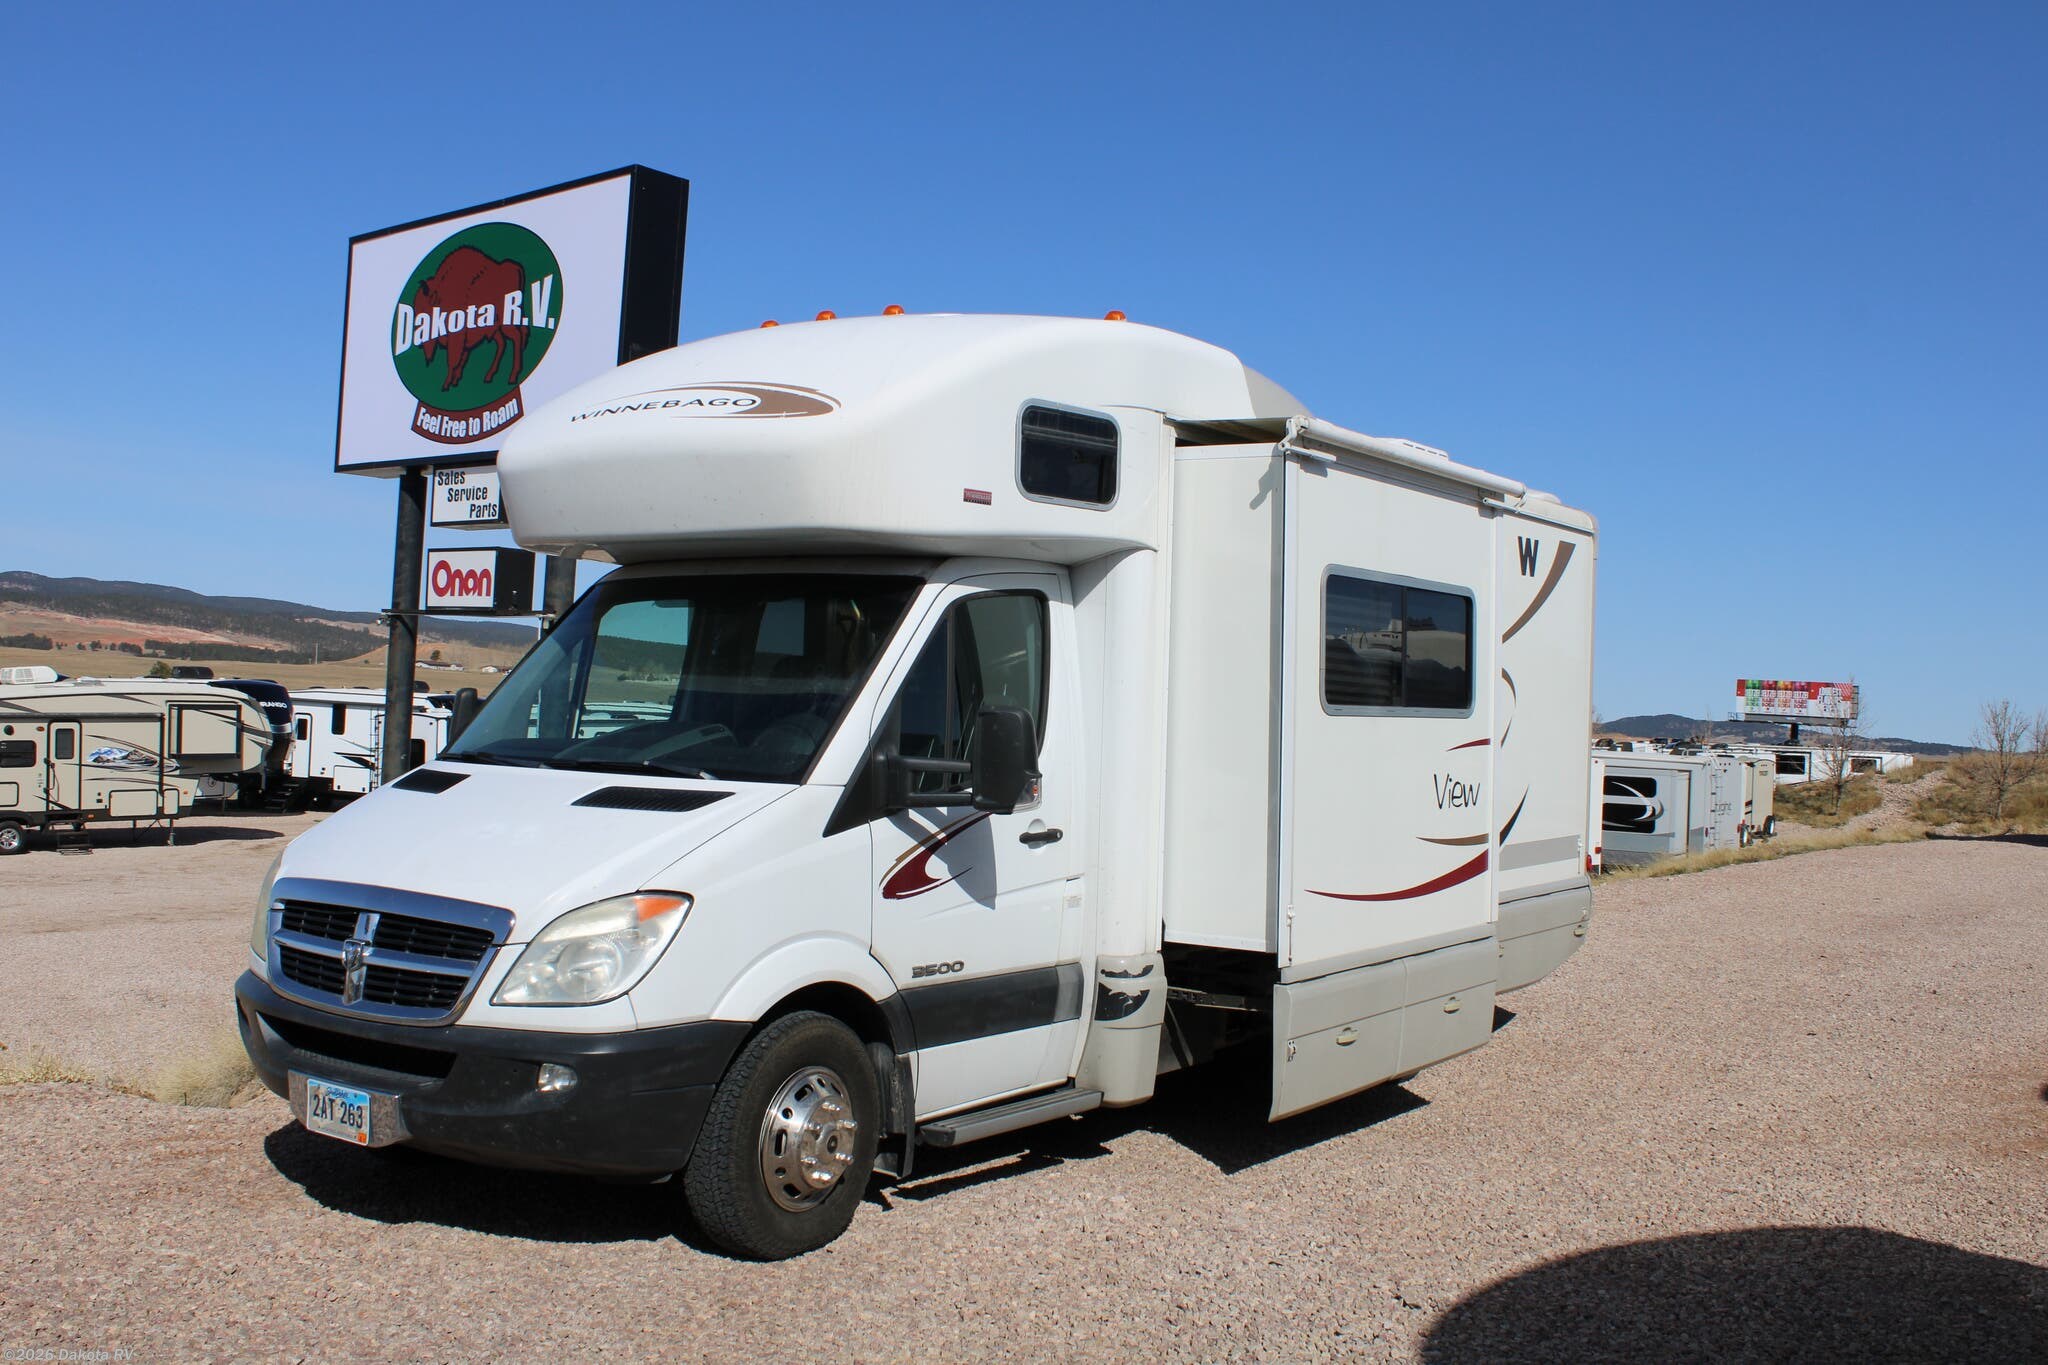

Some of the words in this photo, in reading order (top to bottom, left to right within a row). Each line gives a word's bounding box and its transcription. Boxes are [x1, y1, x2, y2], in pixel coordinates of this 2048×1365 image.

[395, 302, 496, 357] Dakota
[503, 273, 555, 330] R.V.
[416, 406, 442, 435] Feel
[440, 415, 467, 438] Free
[468, 417, 481, 436] to
[482, 398, 519, 433] Roam
[571, 398, 757, 423] WINNEBAGO
[437, 470, 466, 487] Sales
[447, 486, 488, 503] Service
[469, 502, 498, 519] Parts
[1517, 536, 1539, 577] W
[431, 559, 492, 598] Onan
[1433, 773, 1481, 810] View
[912, 960, 964, 978] 3500
[313, 1094, 335, 1121] 2AT
[340, 1101, 363, 1129] 263
